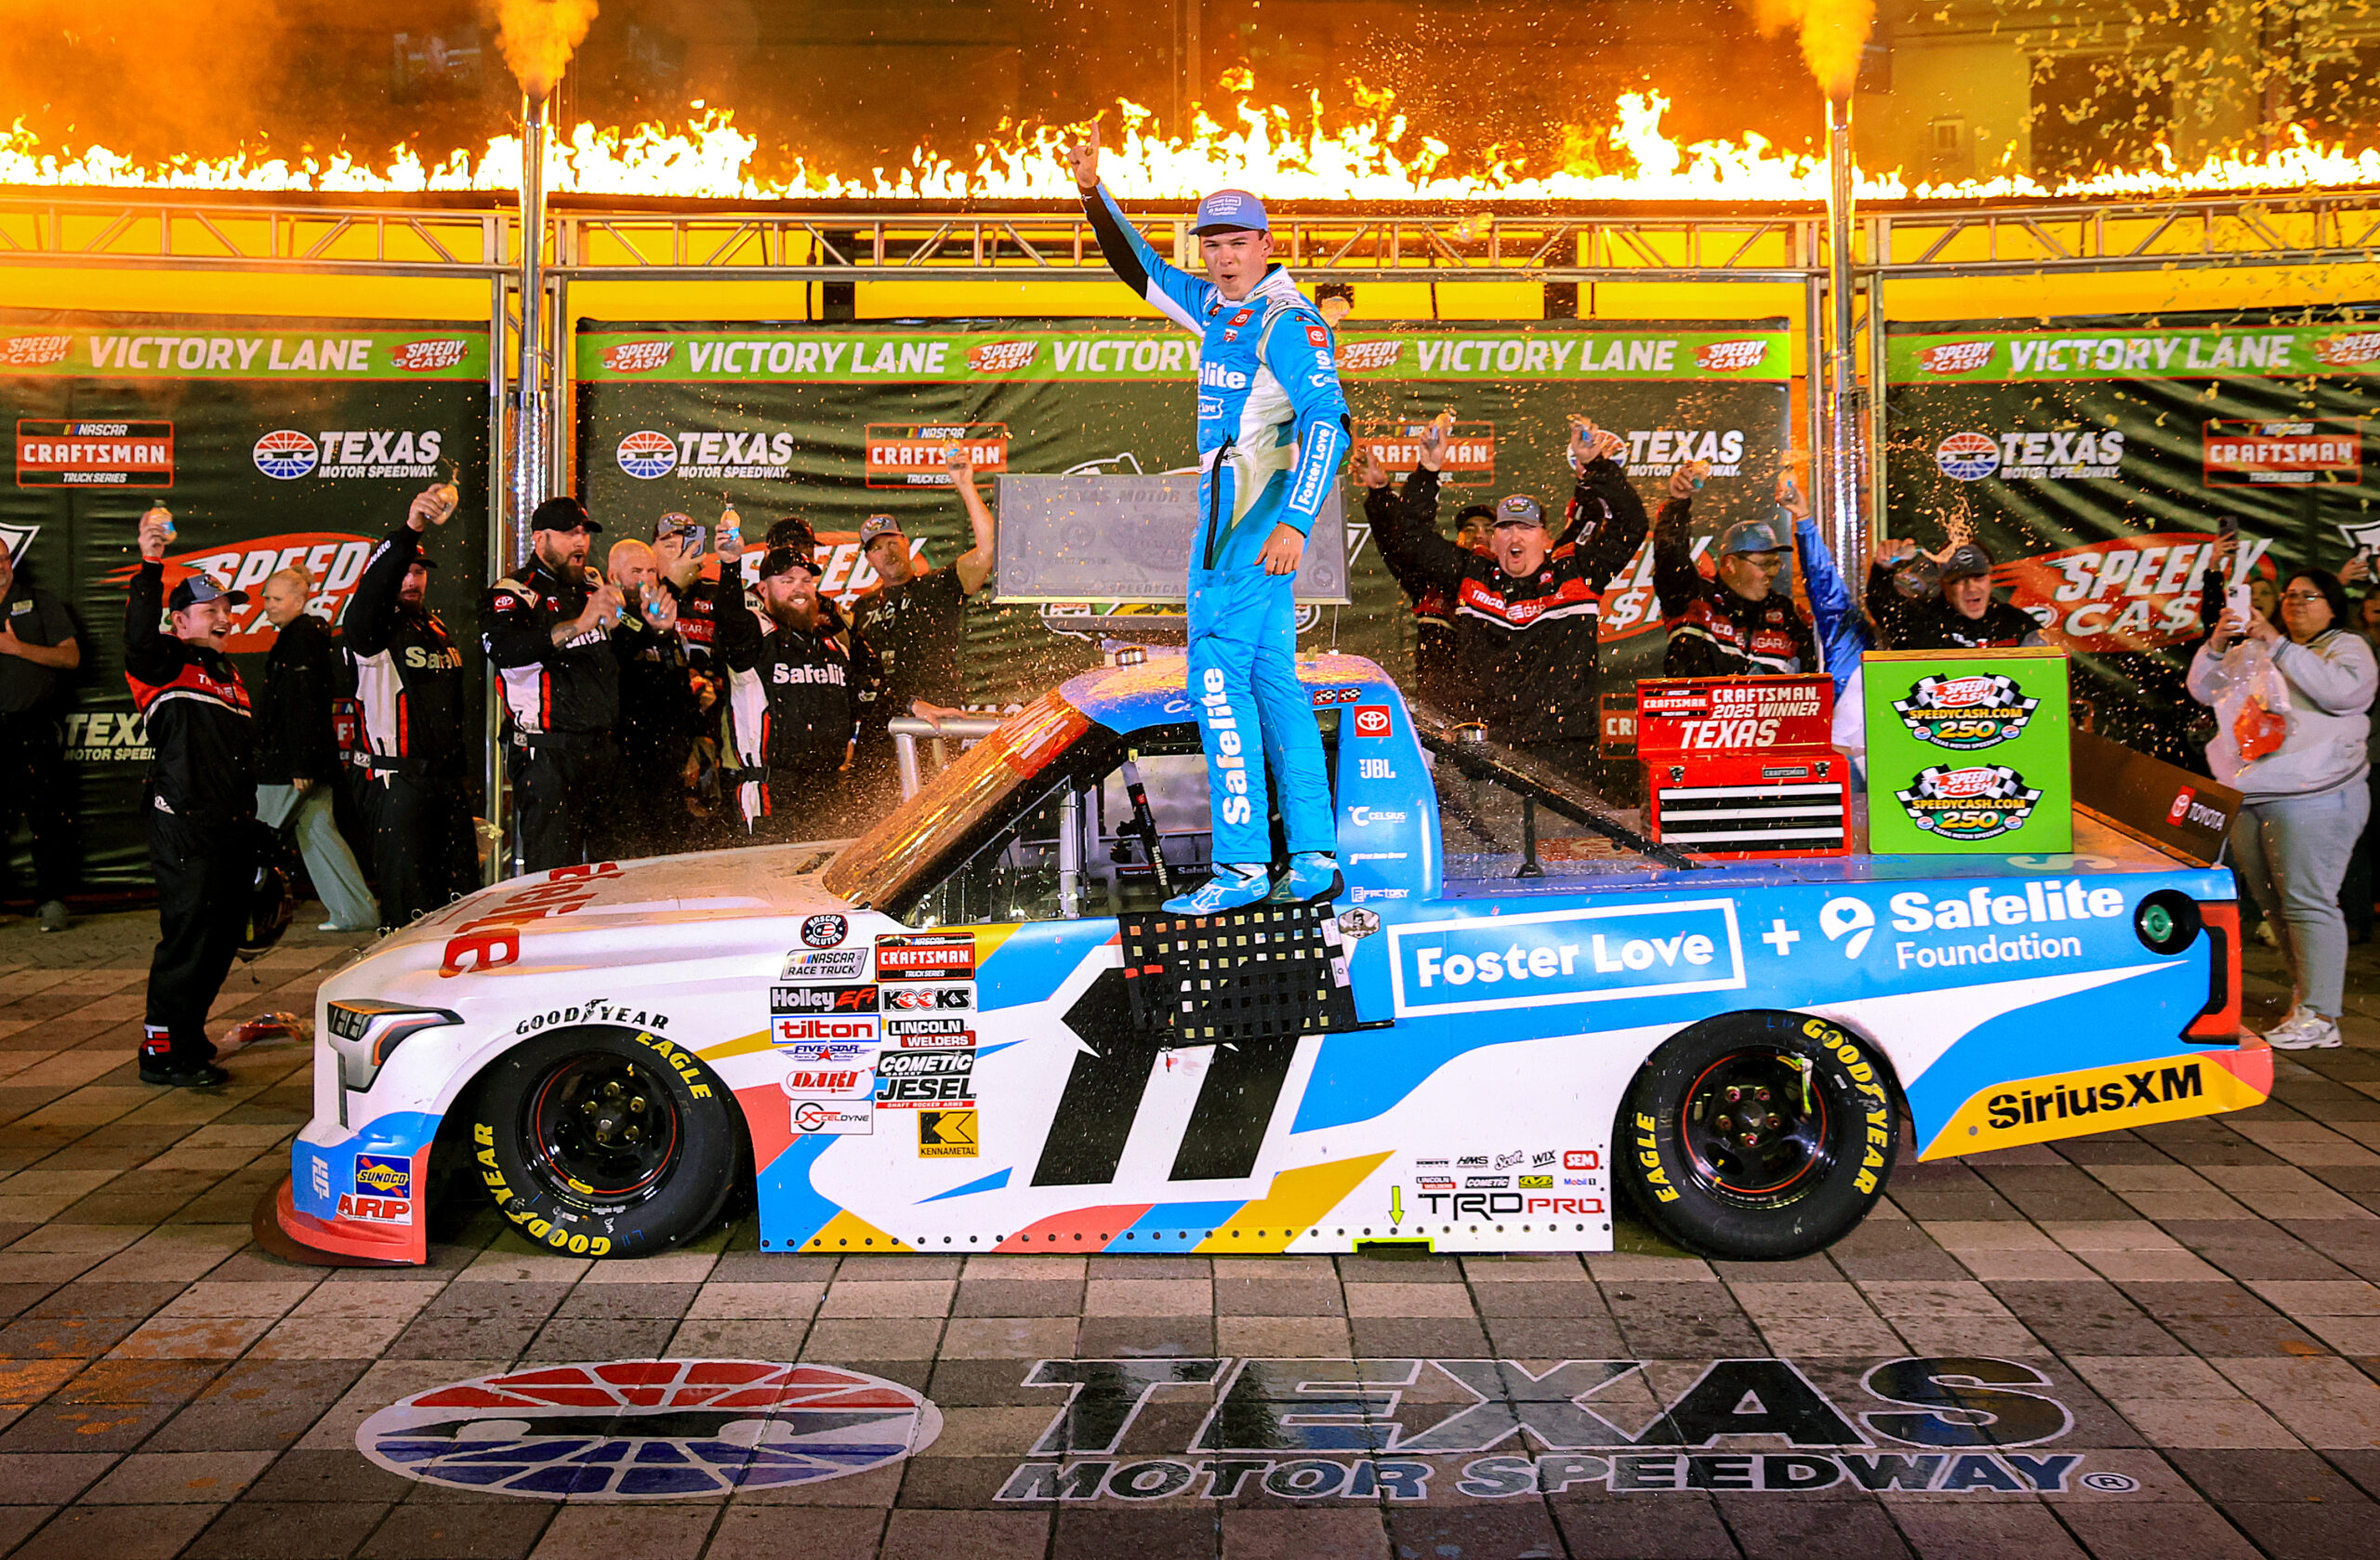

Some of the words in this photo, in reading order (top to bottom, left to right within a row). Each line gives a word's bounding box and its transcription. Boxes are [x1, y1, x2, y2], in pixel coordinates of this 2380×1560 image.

[7, 336, 72, 353] SPEEDY
[89, 337, 263, 370] VICTORY
[269, 339, 372, 371] LANE
[405, 340, 466, 359] SPEEDY
[615, 341, 674, 361] SPEEDY
[980, 340, 1038, 361] SPEEDY
[1342, 341, 1403, 360] SPEEDY
[1709, 340, 1767, 359] SPEEDY
[1933, 341, 1995, 362] SPEEDY
[2010, 338, 2182, 372] VICTORY
[2186, 336, 2294, 369] LANE
[689, 342, 847, 373] VICTORY
[851, 342, 949, 374] LANE
[1053, 340, 1201, 372] VICTORY
[1417, 340, 1576, 371] VICTORY
[1580, 340, 1678, 371] LANE
[78, 425, 128, 437] NASCAR
[921, 428, 965, 439] NASCAR
[23, 443, 165, 463] CRAFTSMAN
[319, 430, 442, 465] TEXAS
[678, 432, 794, 465] TEXAS
[1627, 430, 1744, 464] TEXAS
[2001, 430, 2124, 465] TEXAS
[2210, 443, 2353, 463] CRAFTSMAN
[319, 466, 366, 478] MOTOR
[368, 466, 437, 478] SPEEDWAY
[678, 466, 721, 478] MOTOR
[723, 466, 790, 479] SPEEDWAY
[1297, 463, 1321, 506] Foster
[1311, 428, 1330, 462] Love
[1627, 464, 1672, 477] MOTOR
[2000, 467, 2047, 480] MOTOR
[63, 473, 94, 483] TRUCK
[94, 473, 127, 483] SERIES
[1712, 687, 1818, 703] CRAFTSMAN
[1946, 680, 1994, 695] SPEEDY
[1644, 698, 1708, 708] CRAFTSMAN
[1712, 704, 1757, 719] 2025
[1758, 702, 1821, 718] WINNER
[1909, 708, 2023, 720] SPEEDYCASH.COM
[1681, 720, 1781, 749] TEXAS
[1937, 721, 1997, 738] 250
[63, 747, 111, 760] MOTOR
[1199, 668, 1250, 826] Safelite
[1359, 759, 1396, 778] JBL
[1949, 770, 1996, 786] SPEEDY
[1911, 799, 2026, 810] SPEEDYCASH.COM
[1938, 811, 2000, 828] 250
[2187, 802, 2227, 830] TOYOTA
[1890, 879, 2124, 932] Safelite
[809, 915, 840, 928] NASCAR
[805, 932, 842, 945] SALUTES
[811, 952, 855, 964] NASCAR
[880, 950, 969, 965] CRAFTSMAN
[1416, 943, 1580, 988] Foster
[1592, 931, 1714, 973] Love
[1896, 932, 2082, 970] Foundation
[787, 965, 816, 975] RACE
[820, 964, 855, 974] TRUCK
[772, 987, 835, 1010] Holley
[836, 987, 877, 1010] EFI
[883, 988, 970, 1011] KOOKS
[515, 1004, 670, 1036] GOODYEAR
[779, 1020, 873, 1038] tilton
[891, 1020, 961, 1035] LINCOLN
[794, 1045, 826, 1054] FIVE
[828, 1044, 860, 1053] STAR
[906, 1035, 969, 1048] WELDERS
[635, 1031, 712, 1100] EAGLE
[879, 1053, 973, 1073] COMETIC
[791, 1069, 866, 1089] DART
[876, 1077, 972, 1101] JESEL
[1986, 1063, 2203, 1131] SiriusXM
[1801, 1018, 1888, 1195] GOODYEAR
[919, 1146, 976, 1156] KENNAMETAL
[1457, 1156, 1488, 1164] HMS
[1532, 1150, 1555, 1164] WIX
[1566, 1153, 1596, 1167] SEM
[1636, 1112, 1680, 1203] EAGLE
[359, 1171, 408, 1184] SUNOCO
[1465, 1178, 1509, 1187] COMETIC
[473, 1122, 612, 1256] GOODYEAR
[337, 1195, 410, 1219] ARP
[1418, 1193, 1523, 1221] TRD
[1527, 1198, 1603, 1214] PRO
[1021, 1355, 2074, 1456] TEXAS
[992, 1459, 1435, 1502] MOTOR
[1456, 1452, 2085, 1499] SPEEDWAY
